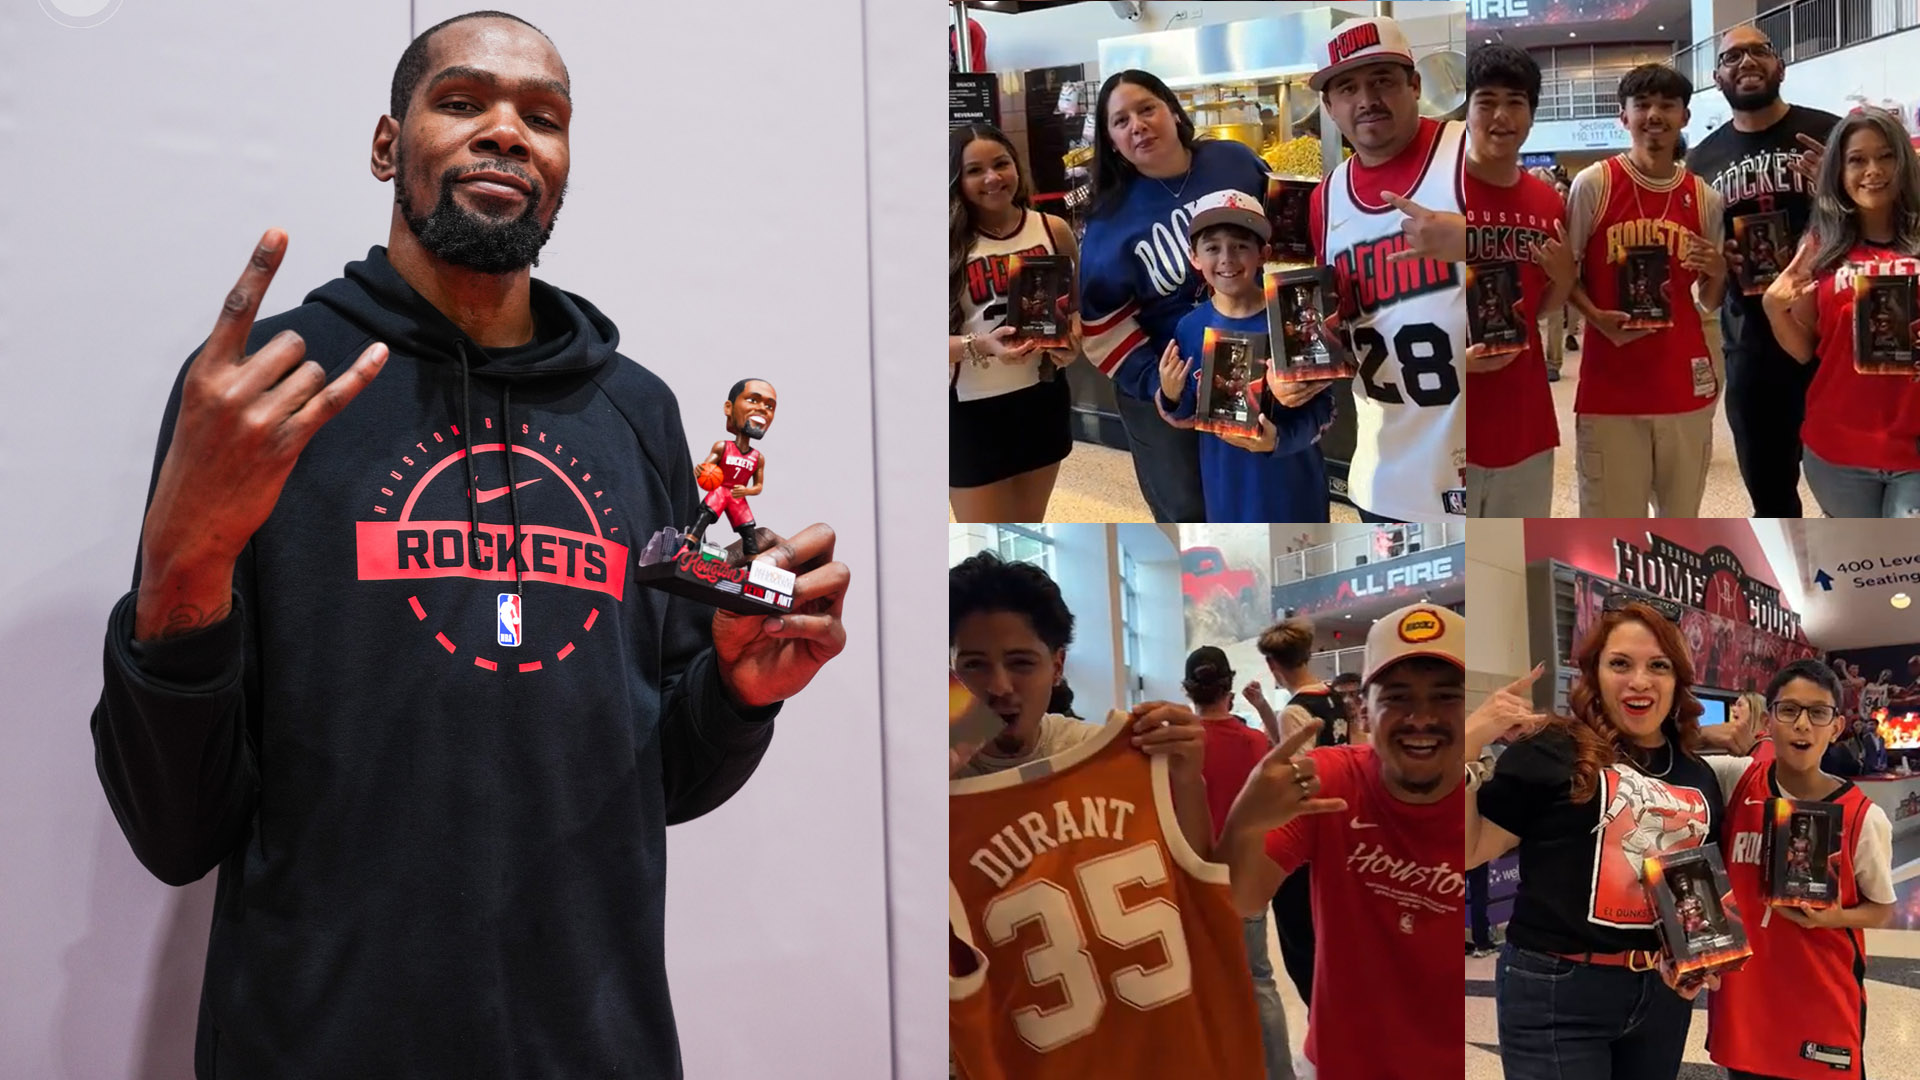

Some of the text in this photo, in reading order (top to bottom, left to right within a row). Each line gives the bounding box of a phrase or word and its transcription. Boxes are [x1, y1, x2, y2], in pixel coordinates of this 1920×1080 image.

[1466, 0, 1529, 19] IRE
[1579, 122, 1615, 132] Sections
[1711, 151, 1819, 209] ROCKET
[1466, 225, 1552, 265] OCKET
[1606, 218, 1691, 265] HOUSTO
[1353, 322, 1460, 407] 28
[373, 417, 619, 535] HOUSTON BSKETBALL
[733, 467, 742, 480] 7
[397, 529, 608, 585] ROCKETS
[680, 550, 746, 584] Houston
[1337, 556, 1452, 600] ALL FIRE
[1661, 543, 1702, 569] SEASON
[1709, 555, 1743, 579] TICKET
[1837, 560, 1874, 574] 400
[1613, 537, 1802, 642] HOME COURT
[500, 633, 513, 643] NBA
[969, 796, 1136, 889] DURANT
[982, 839, 1193, 1053] 35
